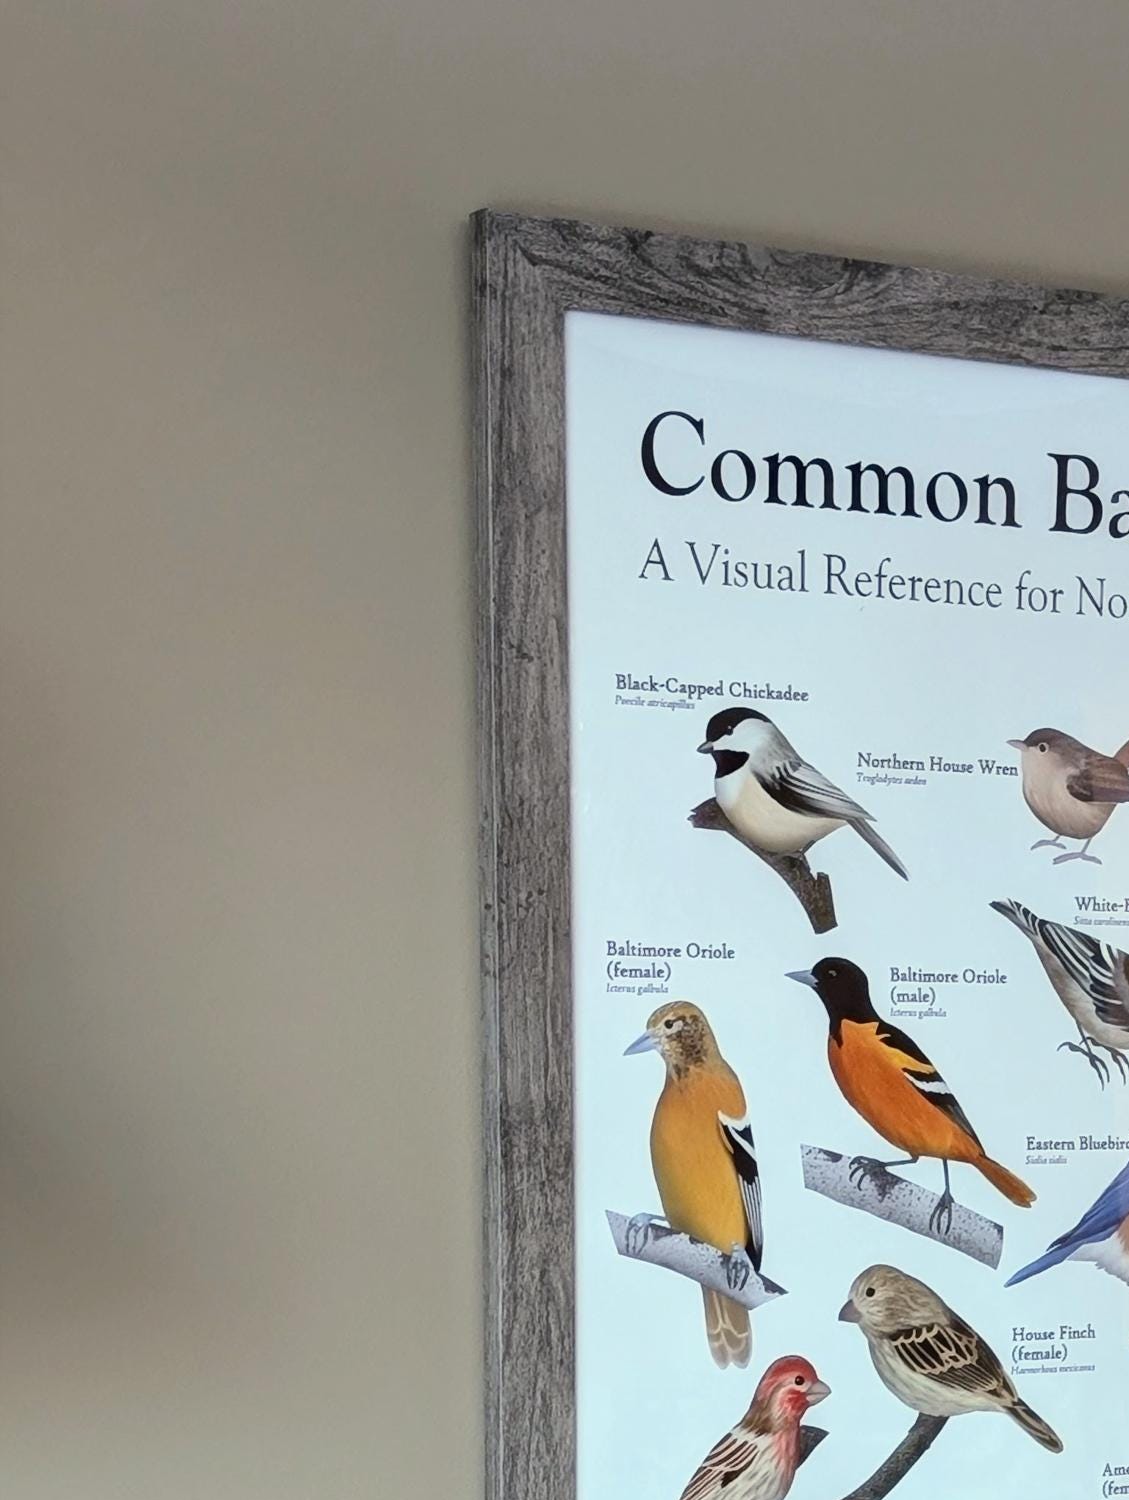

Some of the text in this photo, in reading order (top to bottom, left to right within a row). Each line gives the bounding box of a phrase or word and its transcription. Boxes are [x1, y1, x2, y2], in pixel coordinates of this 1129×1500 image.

[640, 409, 1023, 529] Common
[637, 536, 676, 582] A
[683, 540, 810, 593] Visual
[821, 552, 1003, 609] Reference
[1013, 569, 1065, 614] for
[615, 673, 809, 701] Black-Capped Chickadee
[857, 752, 1018, 776] Northern House Wren
[606, 939, 735, 959] Baltimore Oriole
[606, 957, 671, 982] (female)
[889, 966, 1007, 984] Baltimore Oriole
[890, 984, 936, 1006] (male)
[1026, 1136, 1075, 1150] Eastern
[1012, 1323, 1096, 1341] House Finch
[1011, 1343, 1068, 1362] (female)
